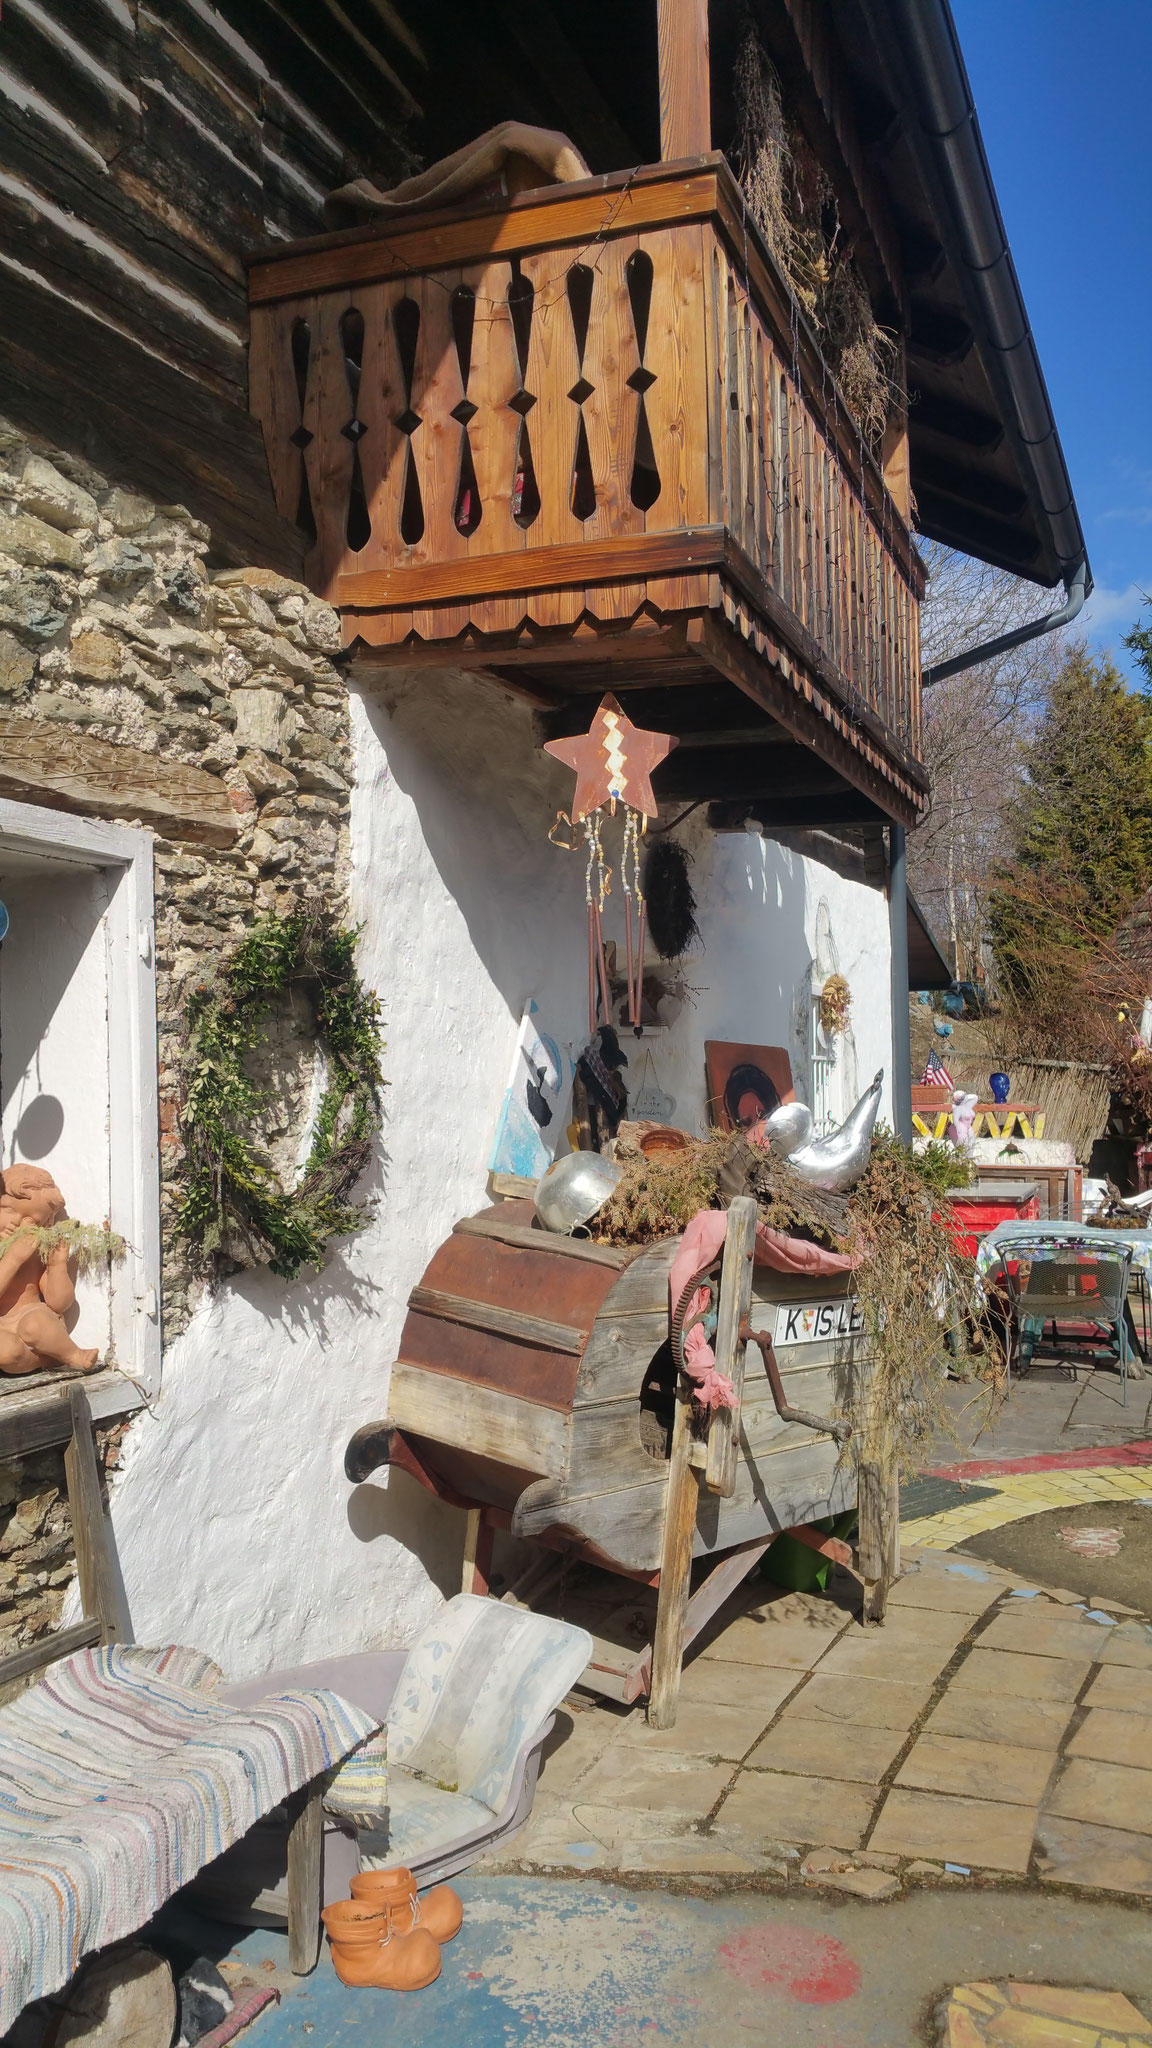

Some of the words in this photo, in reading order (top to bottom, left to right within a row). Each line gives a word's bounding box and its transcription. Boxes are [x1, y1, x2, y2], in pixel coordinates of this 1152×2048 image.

[637, 1108, 664, 1118] garden
[785, 1308, 803, 1340] K
[813, 1303, 865, 1337] ISLE
